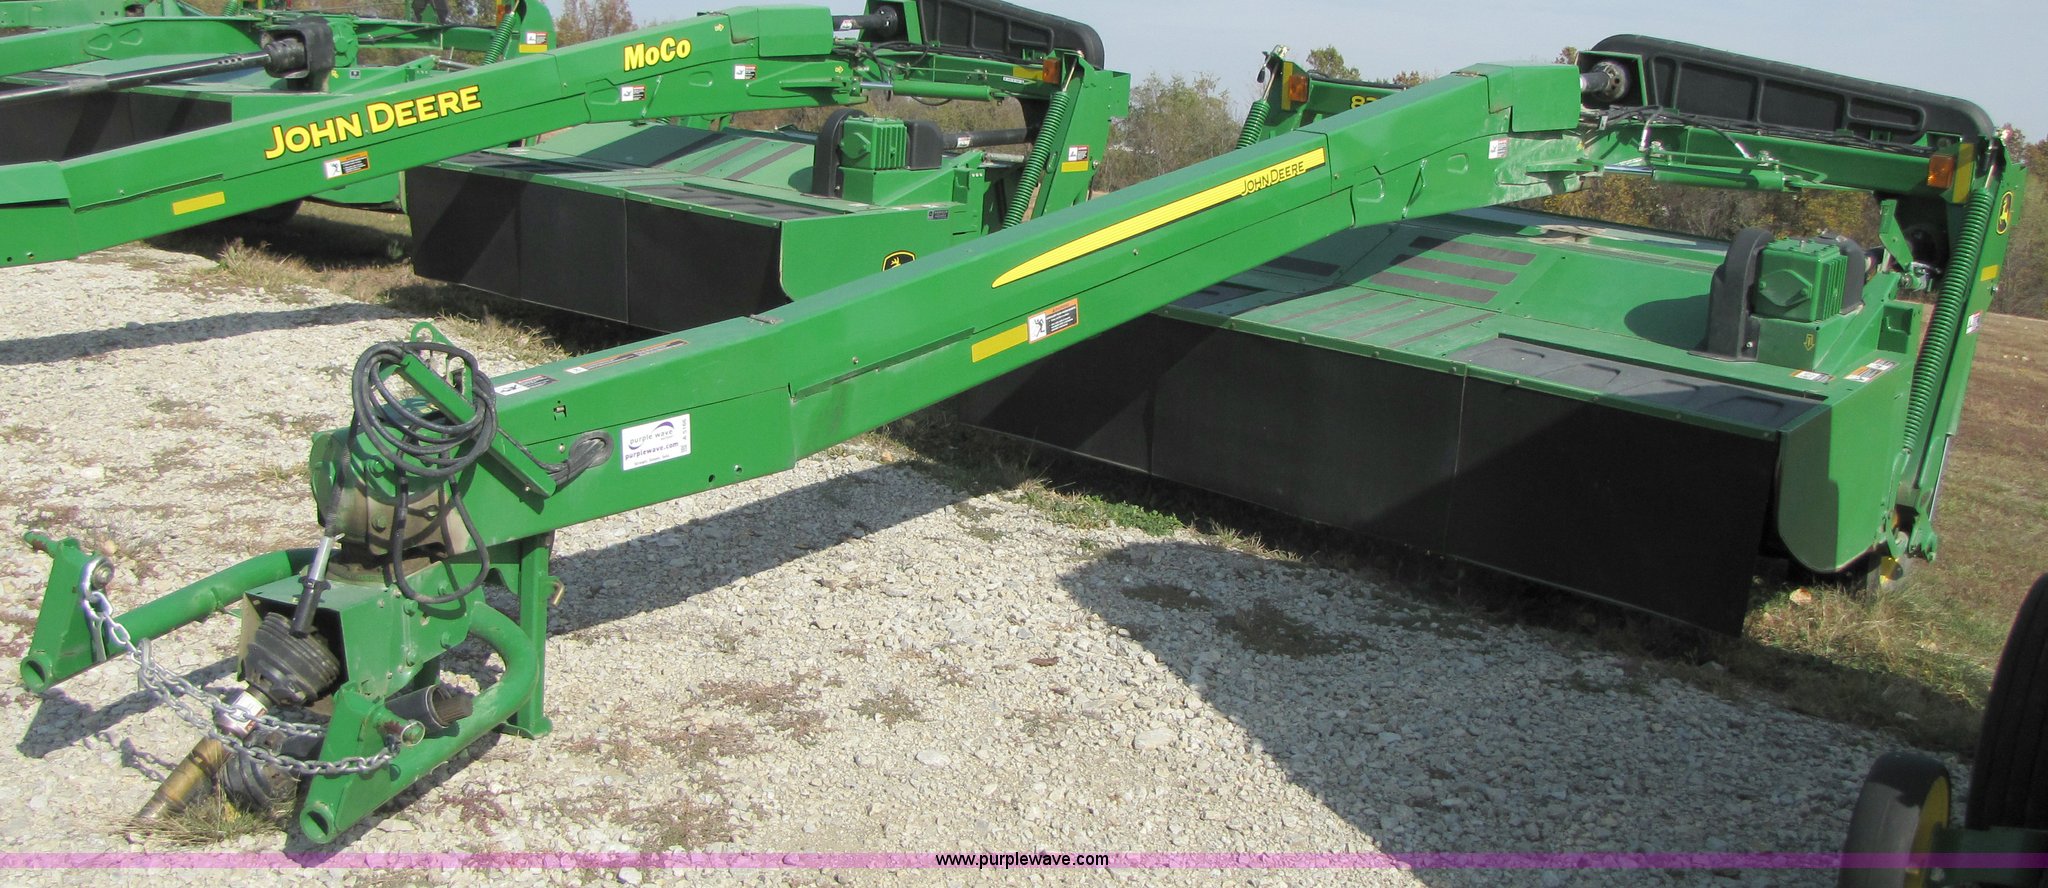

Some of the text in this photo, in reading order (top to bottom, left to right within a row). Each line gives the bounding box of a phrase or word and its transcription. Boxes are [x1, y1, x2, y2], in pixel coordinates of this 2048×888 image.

[624, 36, 692, 72] MoCo
[265, 84, 483, 160] JOHN DEERE
[1241, 161, 1305, 195] JOHN DEERE
[625, 442, 679, 460] purplewave.com
[629, 433, 653, 445] purple
[655, 429, 673, 438] wave
